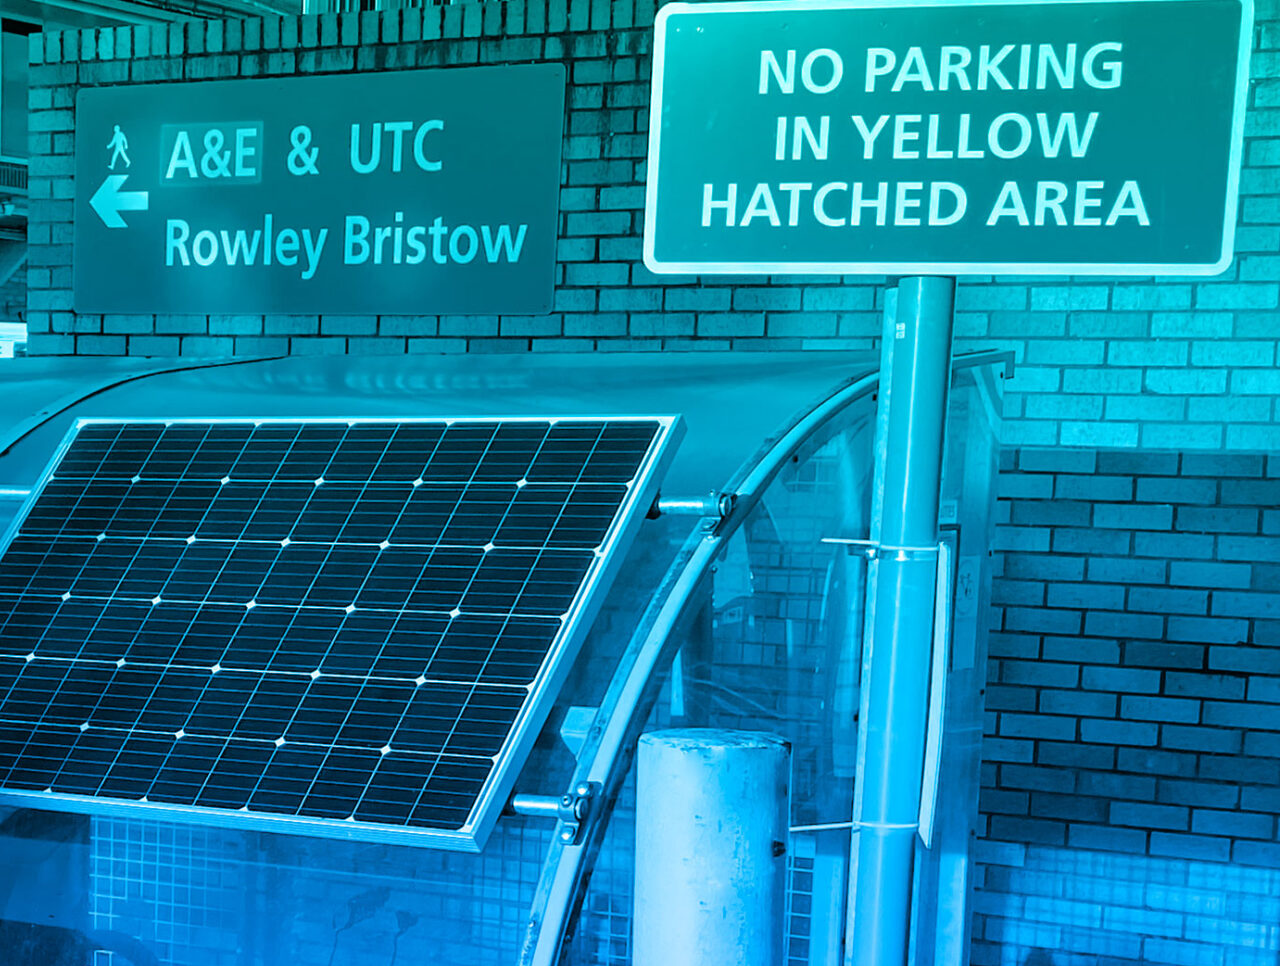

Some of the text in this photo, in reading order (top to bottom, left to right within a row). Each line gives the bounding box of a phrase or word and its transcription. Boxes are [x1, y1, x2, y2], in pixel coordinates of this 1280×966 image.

[757, 41, 1124, 95] NO PARKING
[165, 119, 444, 179] A&E & UTC
[774, 111, 1101, 161] IN YELLOW
[700, 180, 1151, 228] HATCHED AREA
[165, 211, 528, 280] Rowley Bristow
